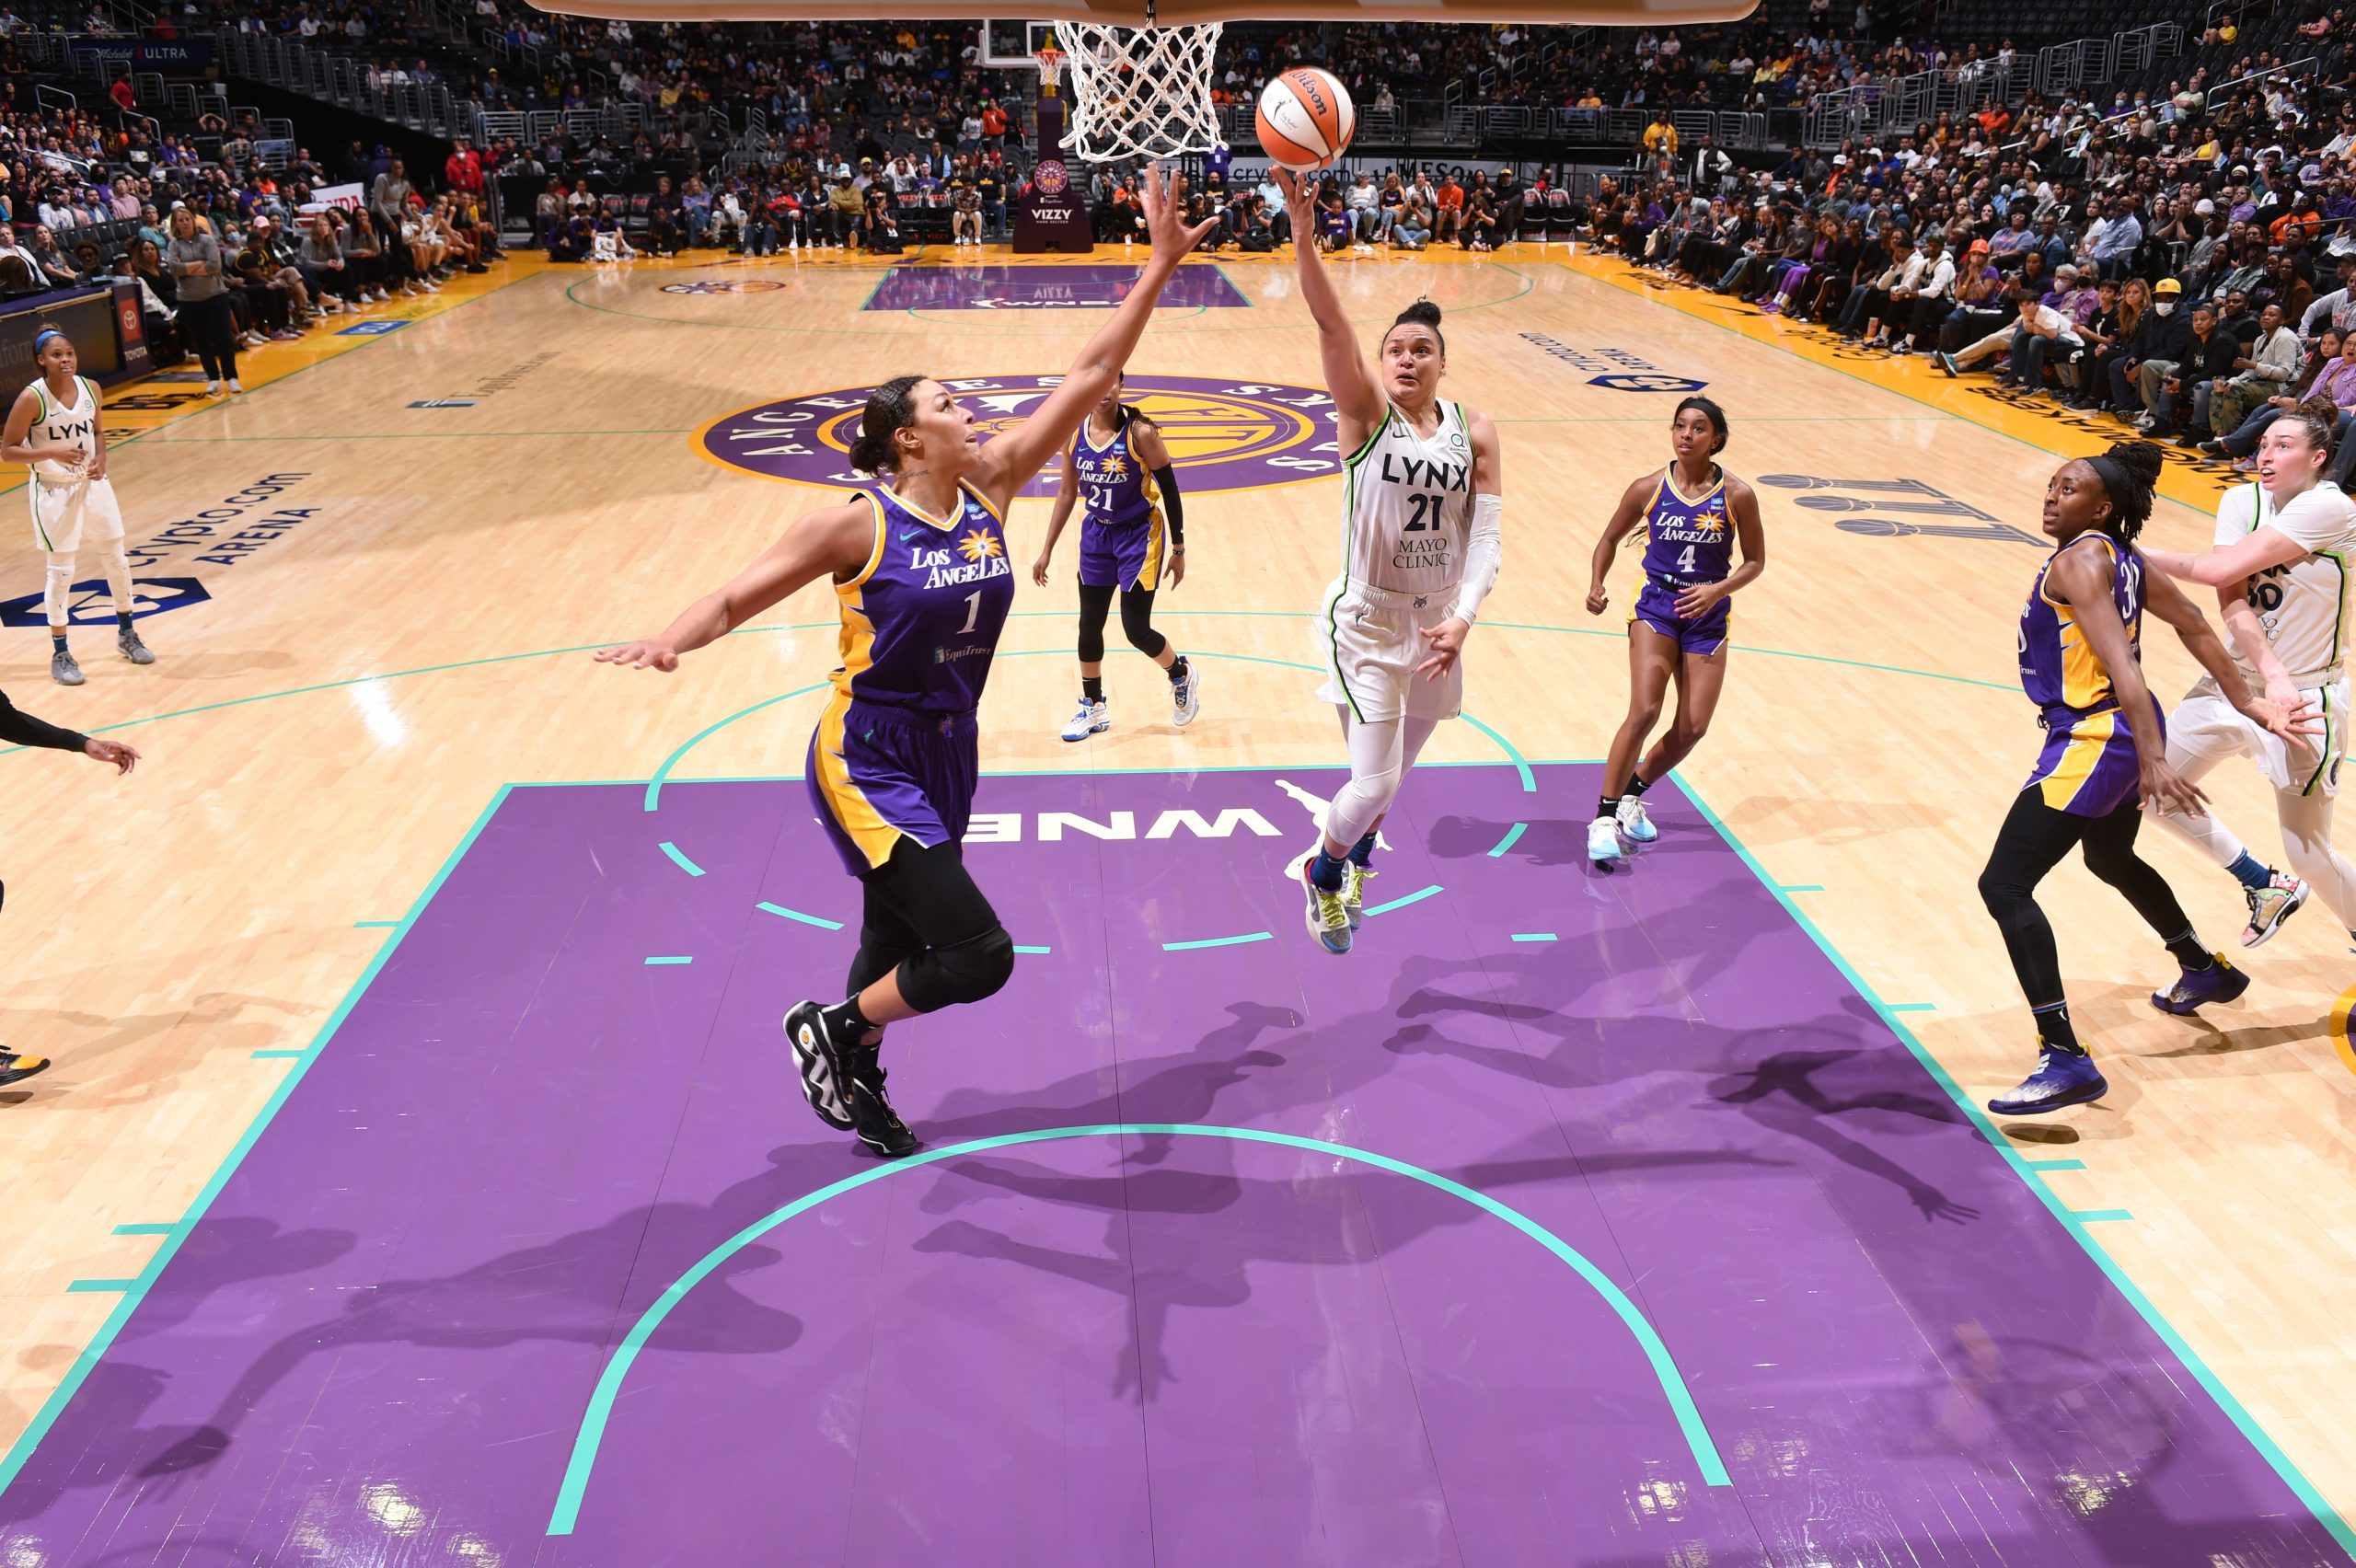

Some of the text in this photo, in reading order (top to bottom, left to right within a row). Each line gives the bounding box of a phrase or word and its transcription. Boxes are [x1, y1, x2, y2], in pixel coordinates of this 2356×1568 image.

[144, 47, 188, 59] ULTRA
[1288, 71, 1327, 117] Wilson
[897, 193, 918, 202] VIZZY
[1032, 209, 1072, 220] VIZZY
[124, 346, 148, 362] TOYOTA
[1593, 348, 1664, 371] ARENA
[1381, 453, 1469, 493] LYNX
[1088, 484, 1114, 512] 21
[1404, 492, 1445, 532] 21
[125, 472, 312, 569] crypto.com
[191, 507, 322, 566] ARENA
[1399, 537, 1448, 553] MAYO
[1392, 553, 1450, 570] CLINIC
[1676, 545, 1696, 573] 4
[955, 590, 981, 635] 1
[944, 644, 993, 663] EquiTrust
[964, 808, 1284, 843] WNB
